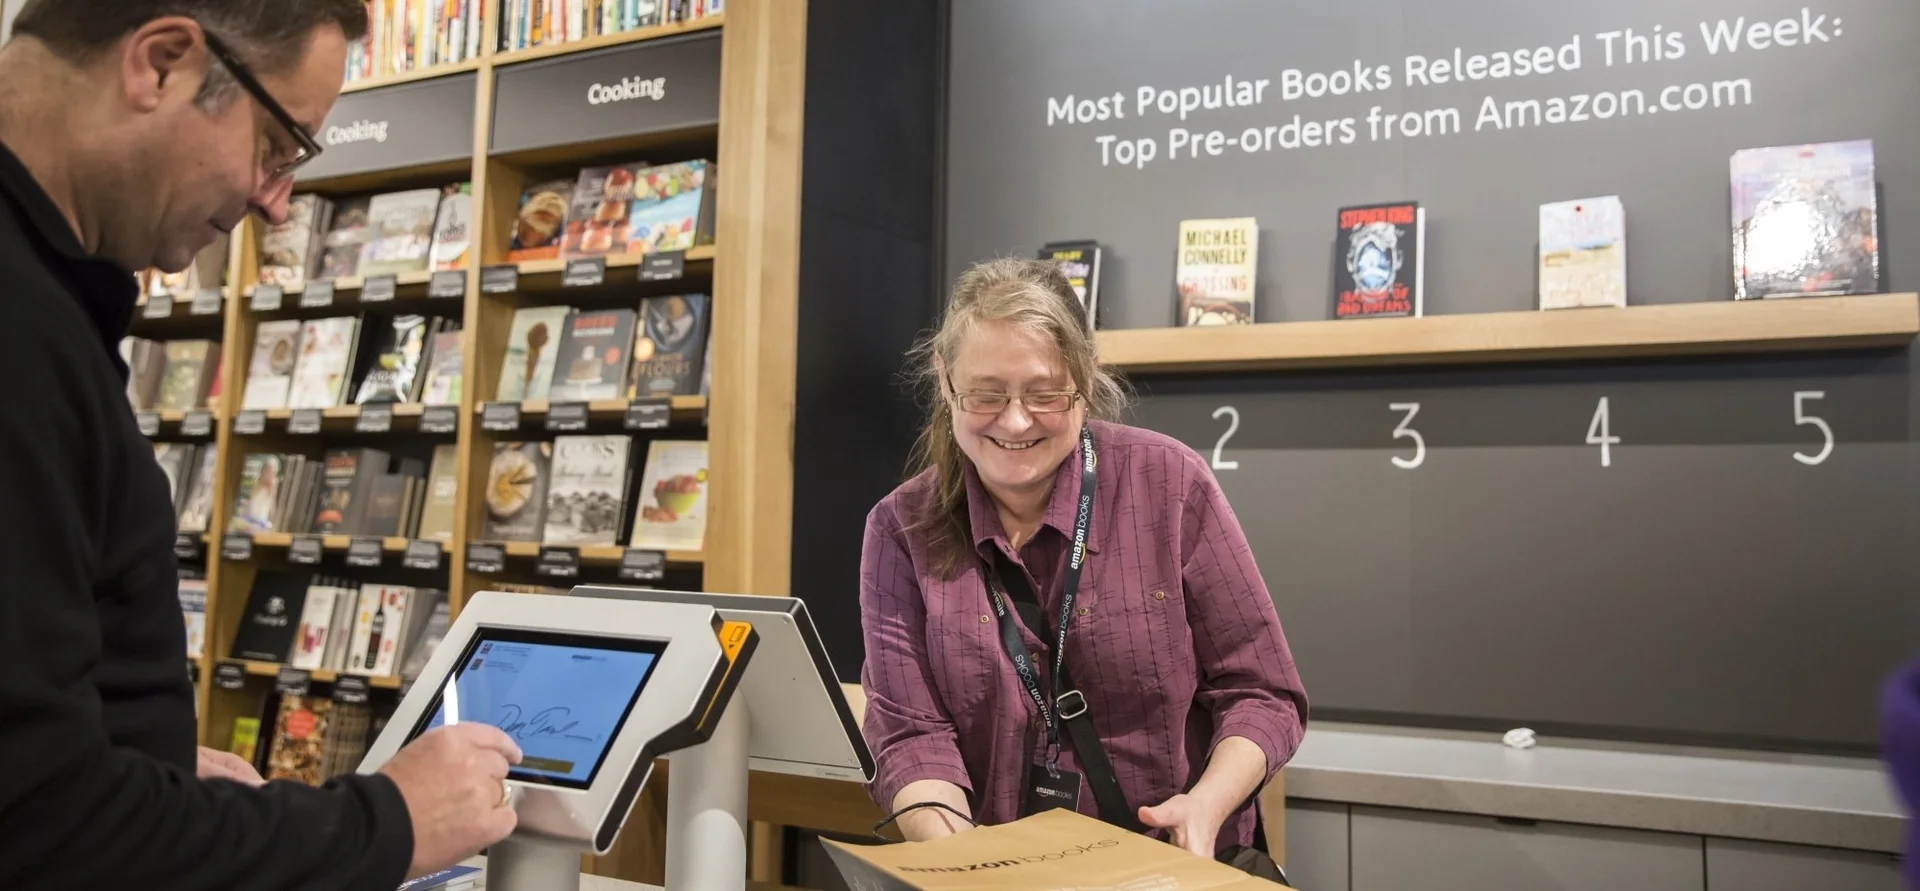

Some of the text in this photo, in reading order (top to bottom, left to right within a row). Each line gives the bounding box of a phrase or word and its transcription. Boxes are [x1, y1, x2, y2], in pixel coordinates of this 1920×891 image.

[587, 76, 666, 105] Cooking
[1047, 7, 1843, 126] Most Popular Books Released This Week:
[326, 119, 389, 145] Cooking
[1095, 78, 1752, 170] Top Pre-orders from Amazon.com
[1184, 247, 1247, 266] CONNELLY
[1186, 229, 1248, 247] MICHAEL
[1211, 405, 1239, 470] 2
[1389, 402, 1426, 469] 3
[1586, 396, 1621, 467] 4
[1792, 391, 1834, 466] 5
